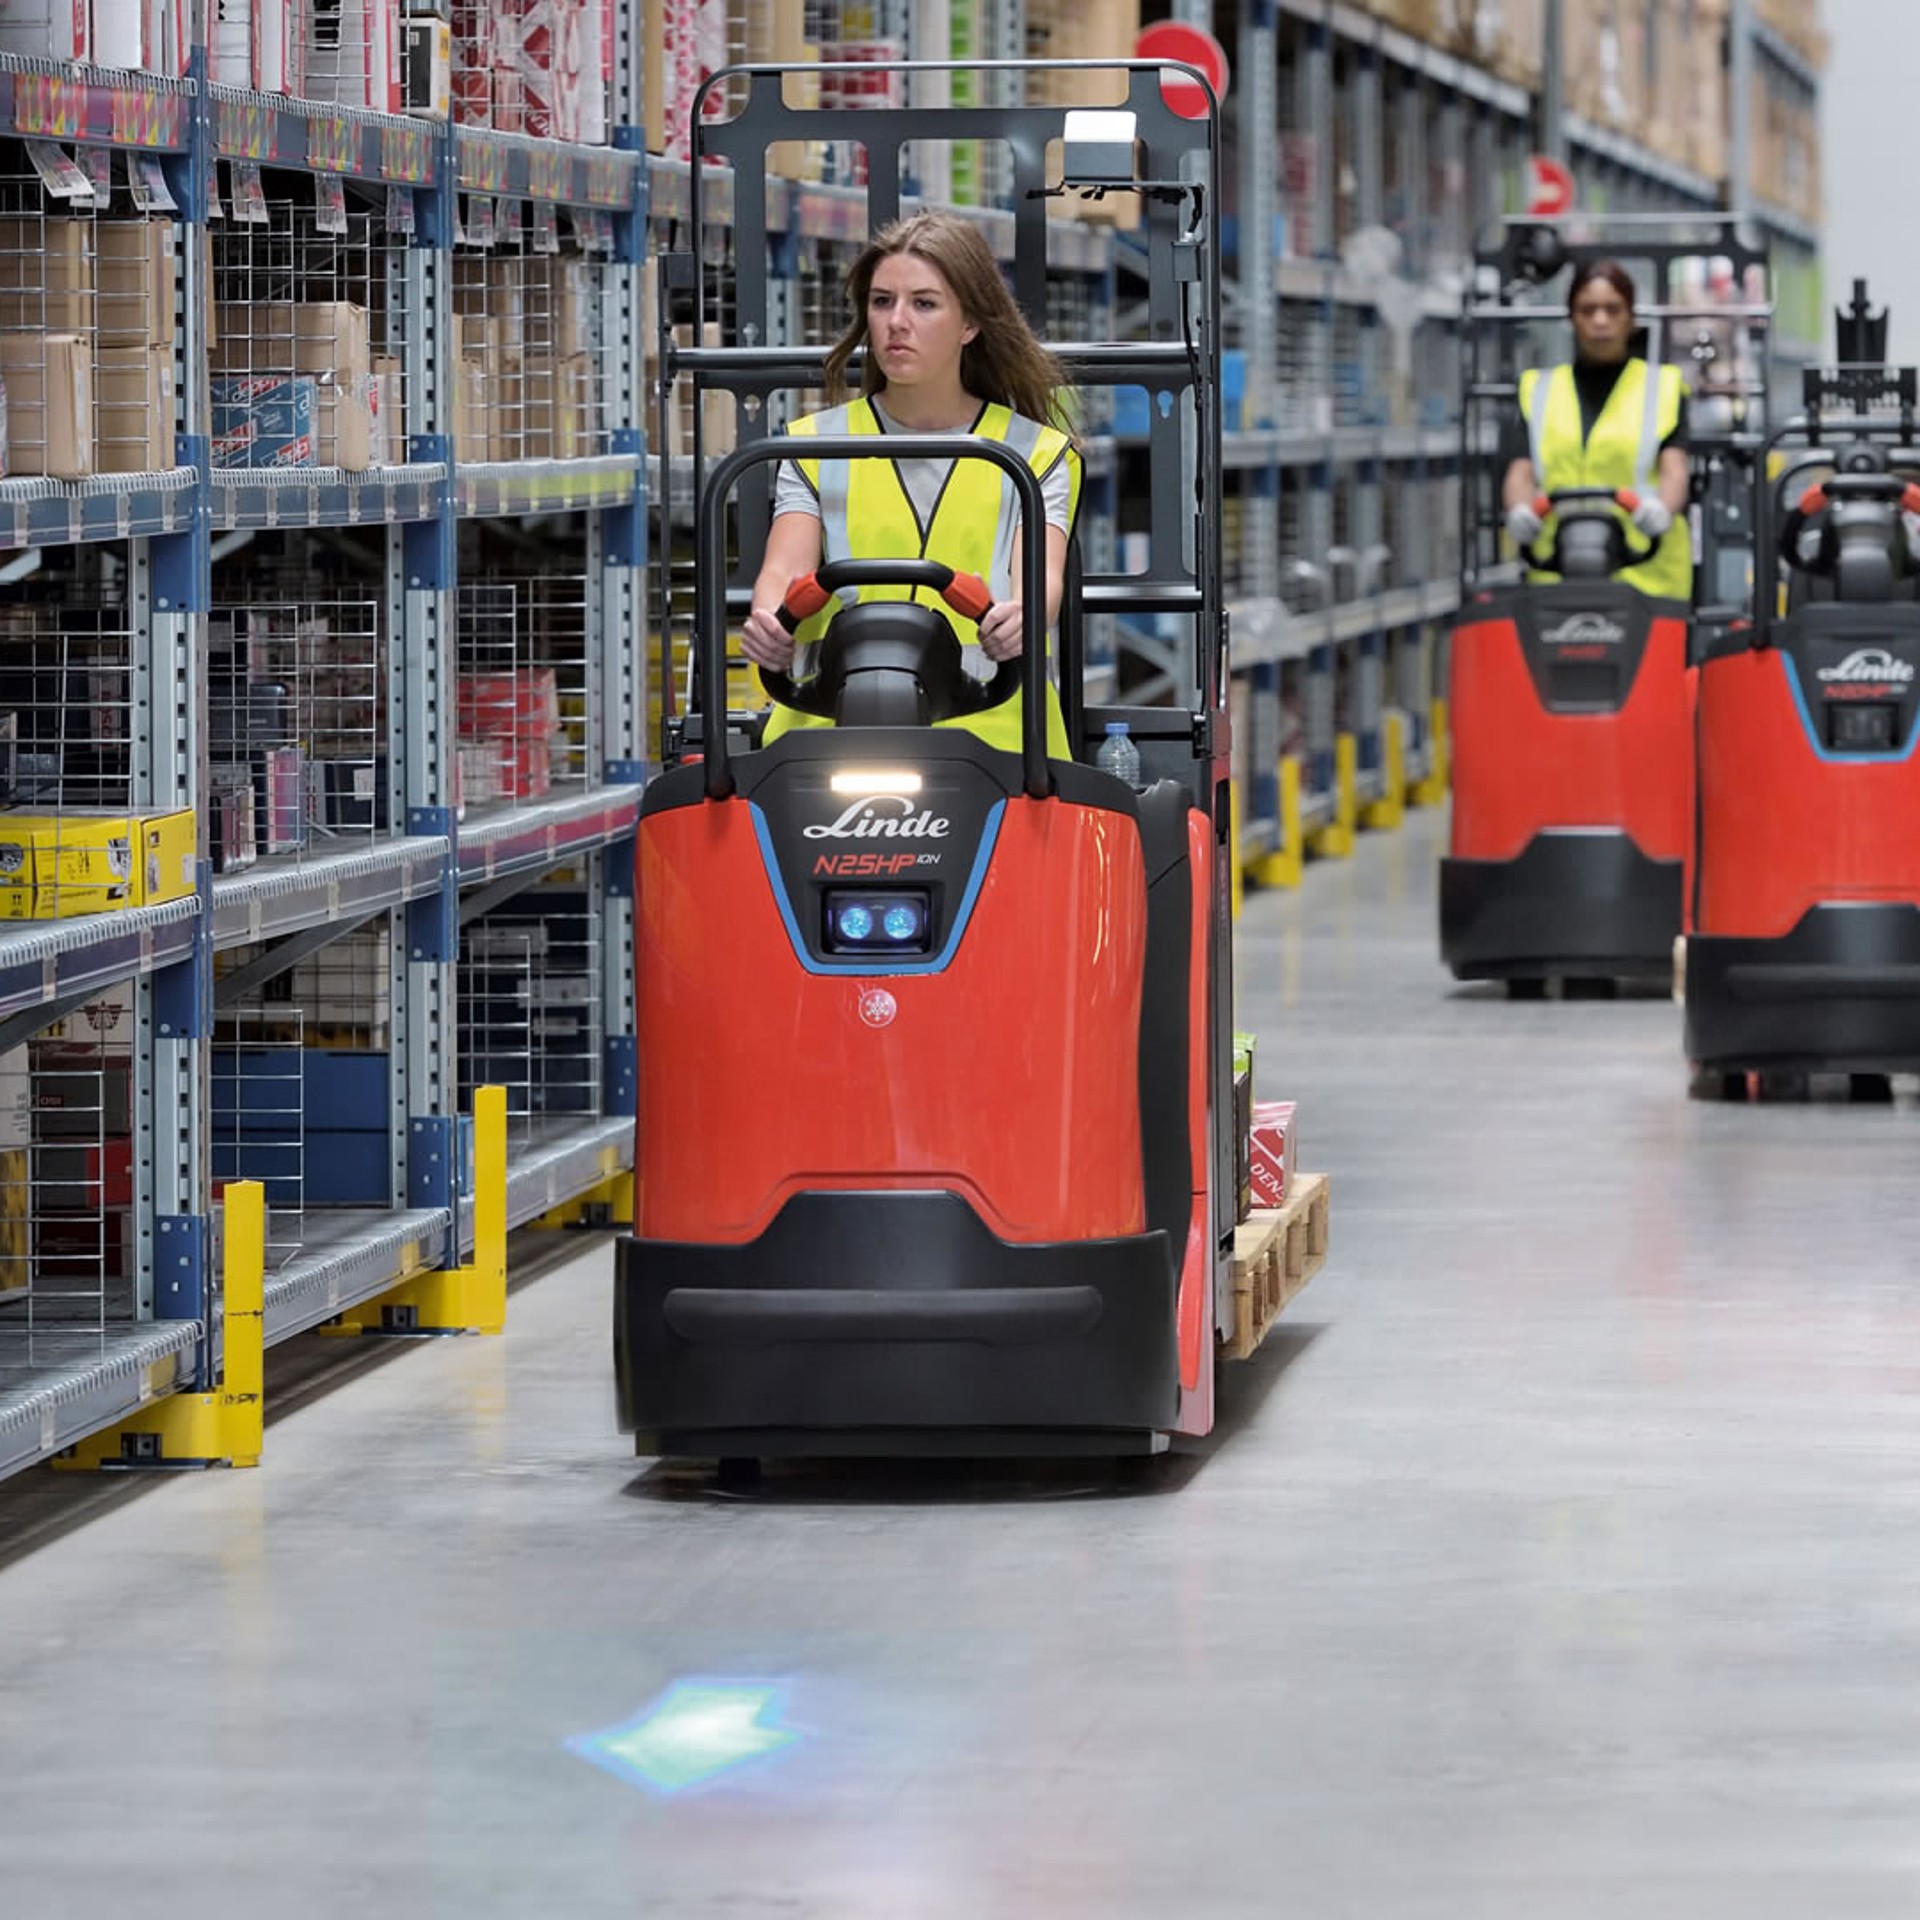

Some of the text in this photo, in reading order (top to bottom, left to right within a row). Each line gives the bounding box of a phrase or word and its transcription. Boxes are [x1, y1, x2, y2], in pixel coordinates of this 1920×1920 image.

[1817, 648, 1914, 681] Linde
[803, 796, 949, 838] Linde
[813, 853, 917, 876] N25HP
